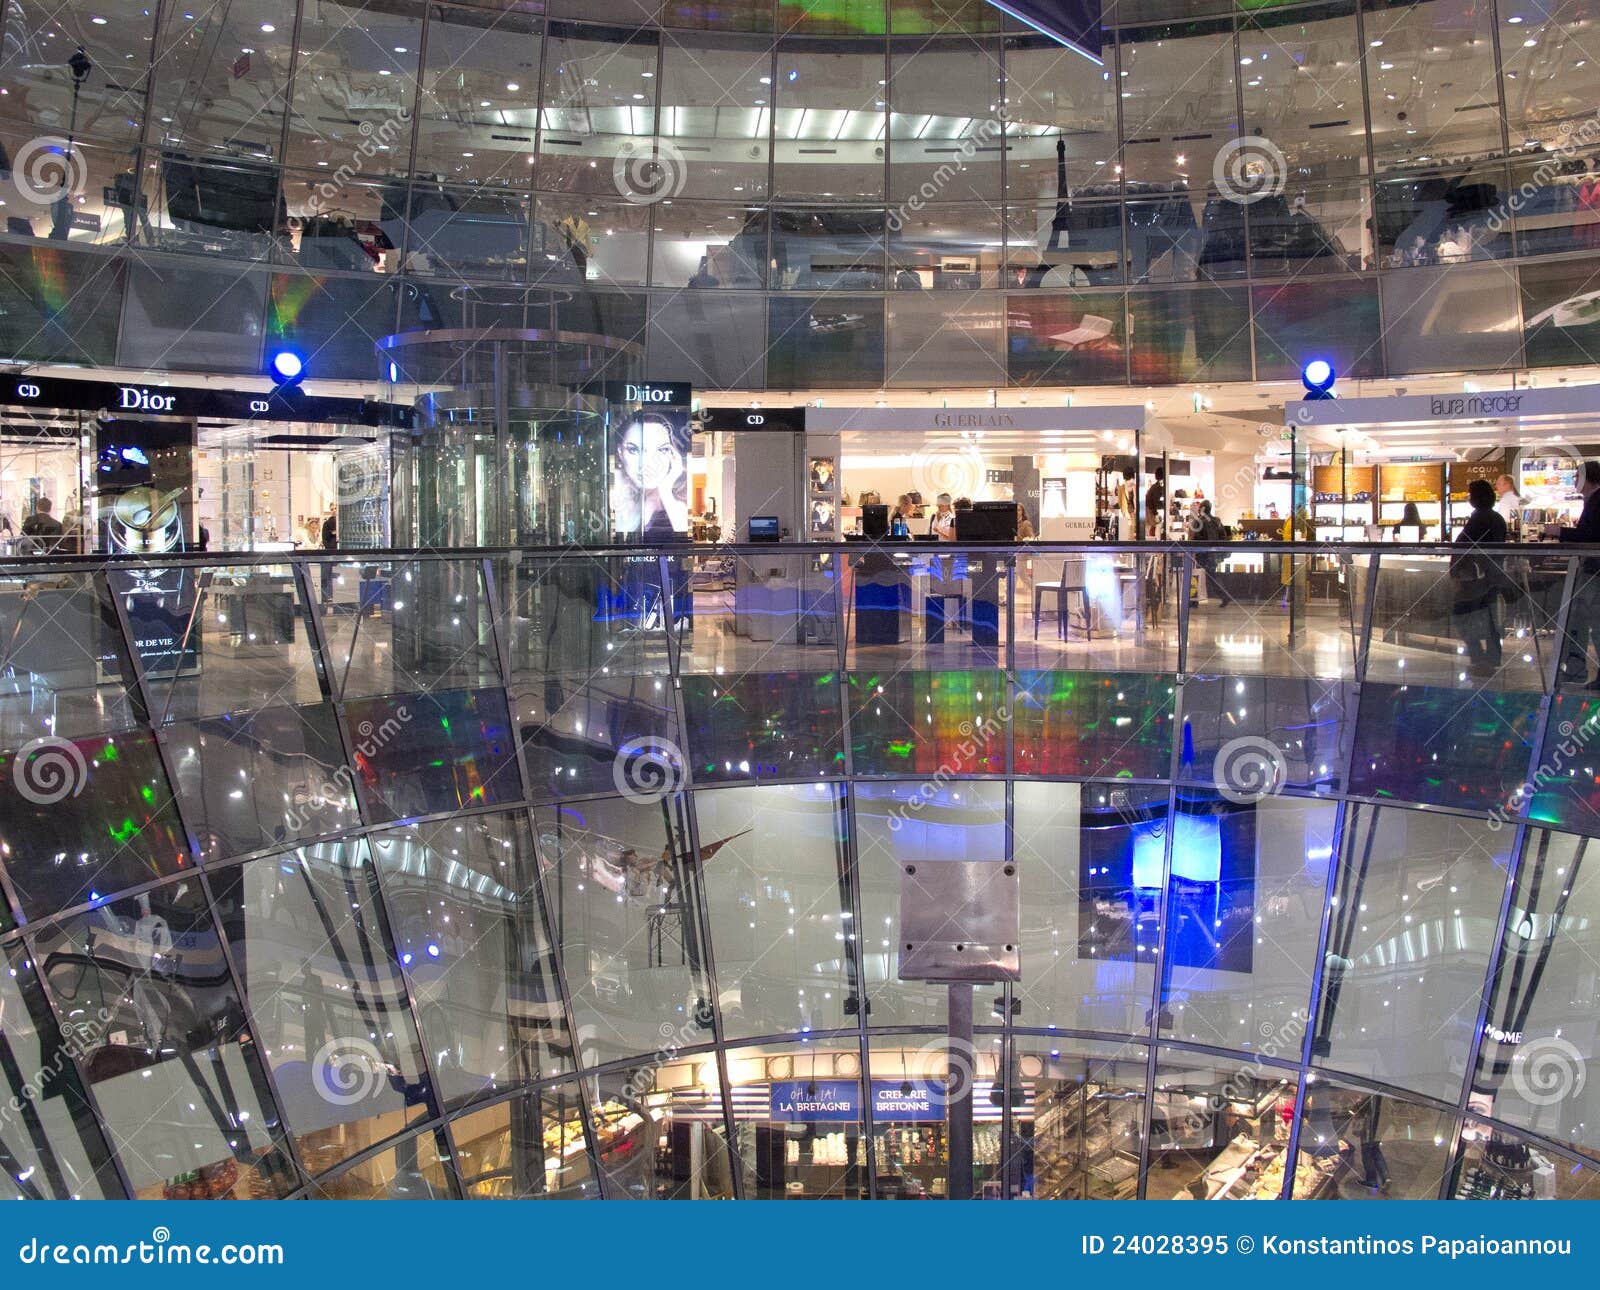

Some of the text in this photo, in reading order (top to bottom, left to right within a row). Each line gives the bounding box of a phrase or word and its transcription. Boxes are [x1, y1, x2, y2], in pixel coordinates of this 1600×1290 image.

[18, 384, 41, 398] CD
[119, 386, 176, 411] Dior
[1431, 391, 1524, 416] laura mercier
[250, 400, 270, 412] CD
[747, 414, 765, 425] CD
[1064, 521, 1095, 529] GUERLAI
[145, 638, 157, 647] DE
[159, 637, 173, 646] VIE
[878, 1089, 928, 1100] CREPRIE
[780, 1101, 795, 1112] LA
[876, 1101, 930, 1112] BRETONNE
